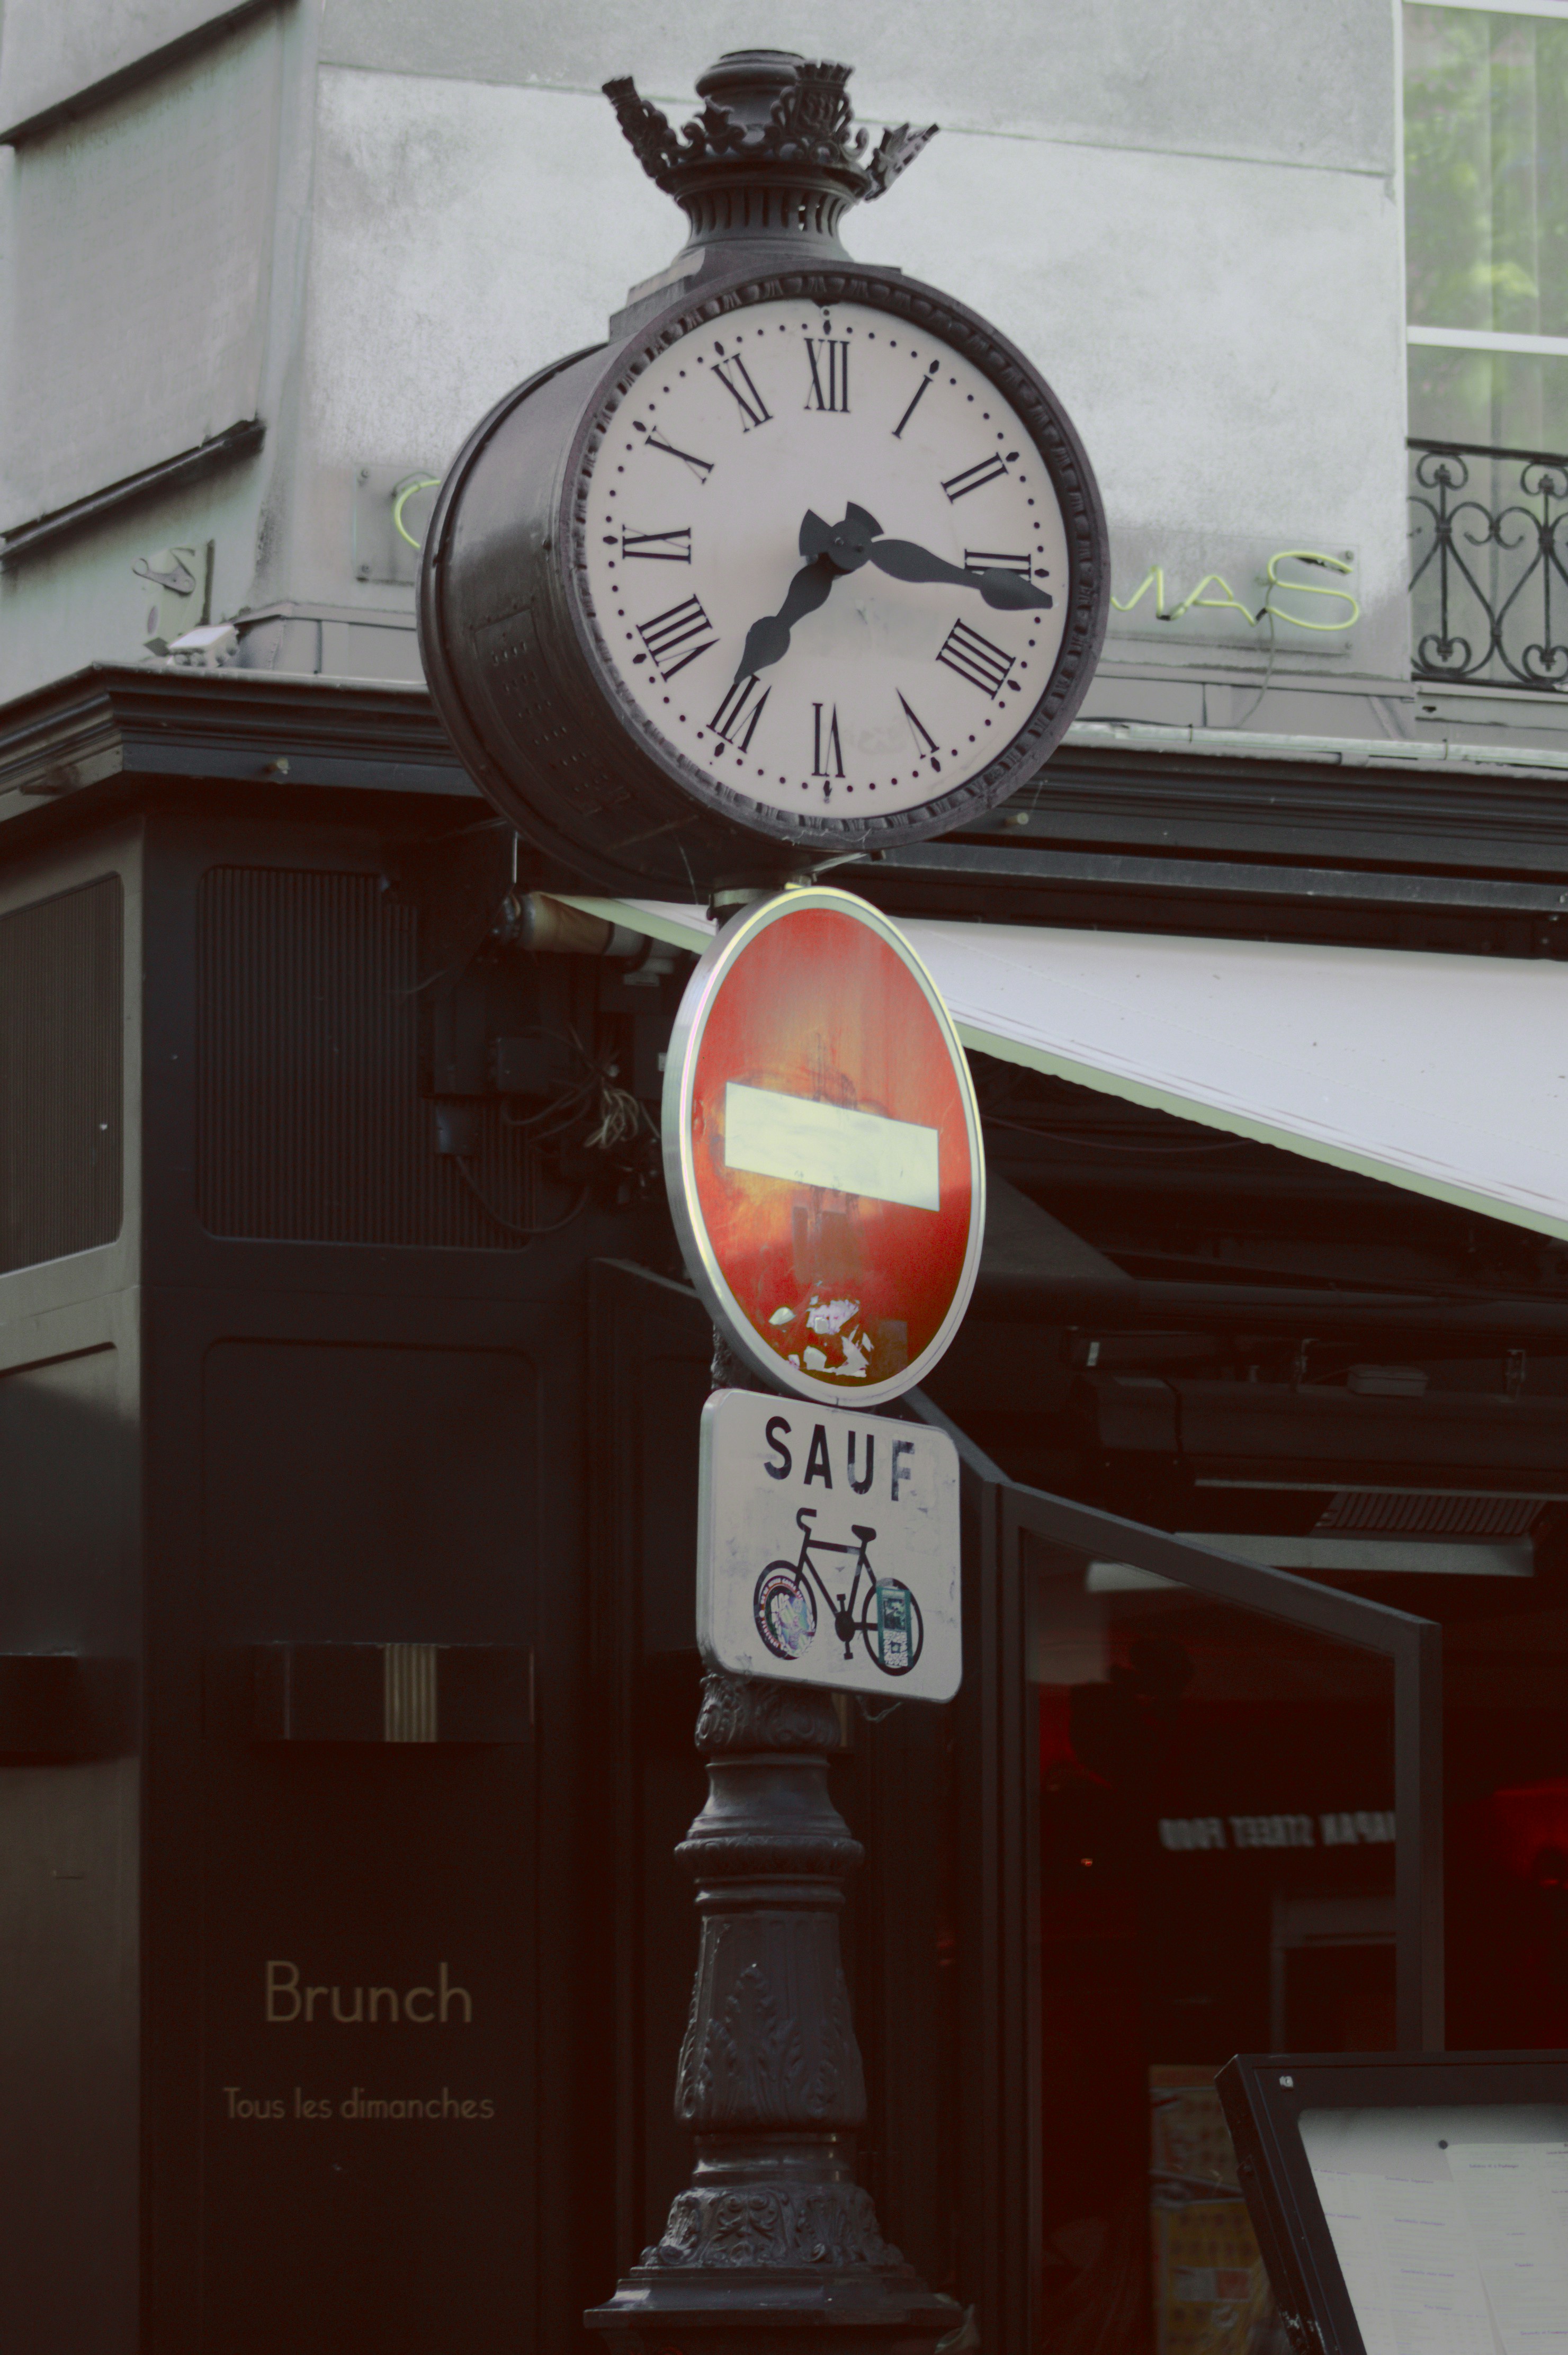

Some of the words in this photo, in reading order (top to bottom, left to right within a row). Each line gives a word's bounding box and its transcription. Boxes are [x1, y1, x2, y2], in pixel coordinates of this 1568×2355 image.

[711, 353, 773, 432] XI
[804, 338, 849, 413] XII
[645, 426, 714, 483] X
[941, 452, 1009, 504] II
[622, 525, 691, 563] IX
[635, 594, 720, 683] VIII
[811, 703, 845, 779] VI
[897, 688, 940, 759] V
[764, 1416, 915, 1501] SAUF
[265, 1960, 473, 2023] Brunch
[224, 2087, 286, 2119] Tous
[293, 2087, 333, 2119] les
[340, 2087, 495, 2119] dimanches
